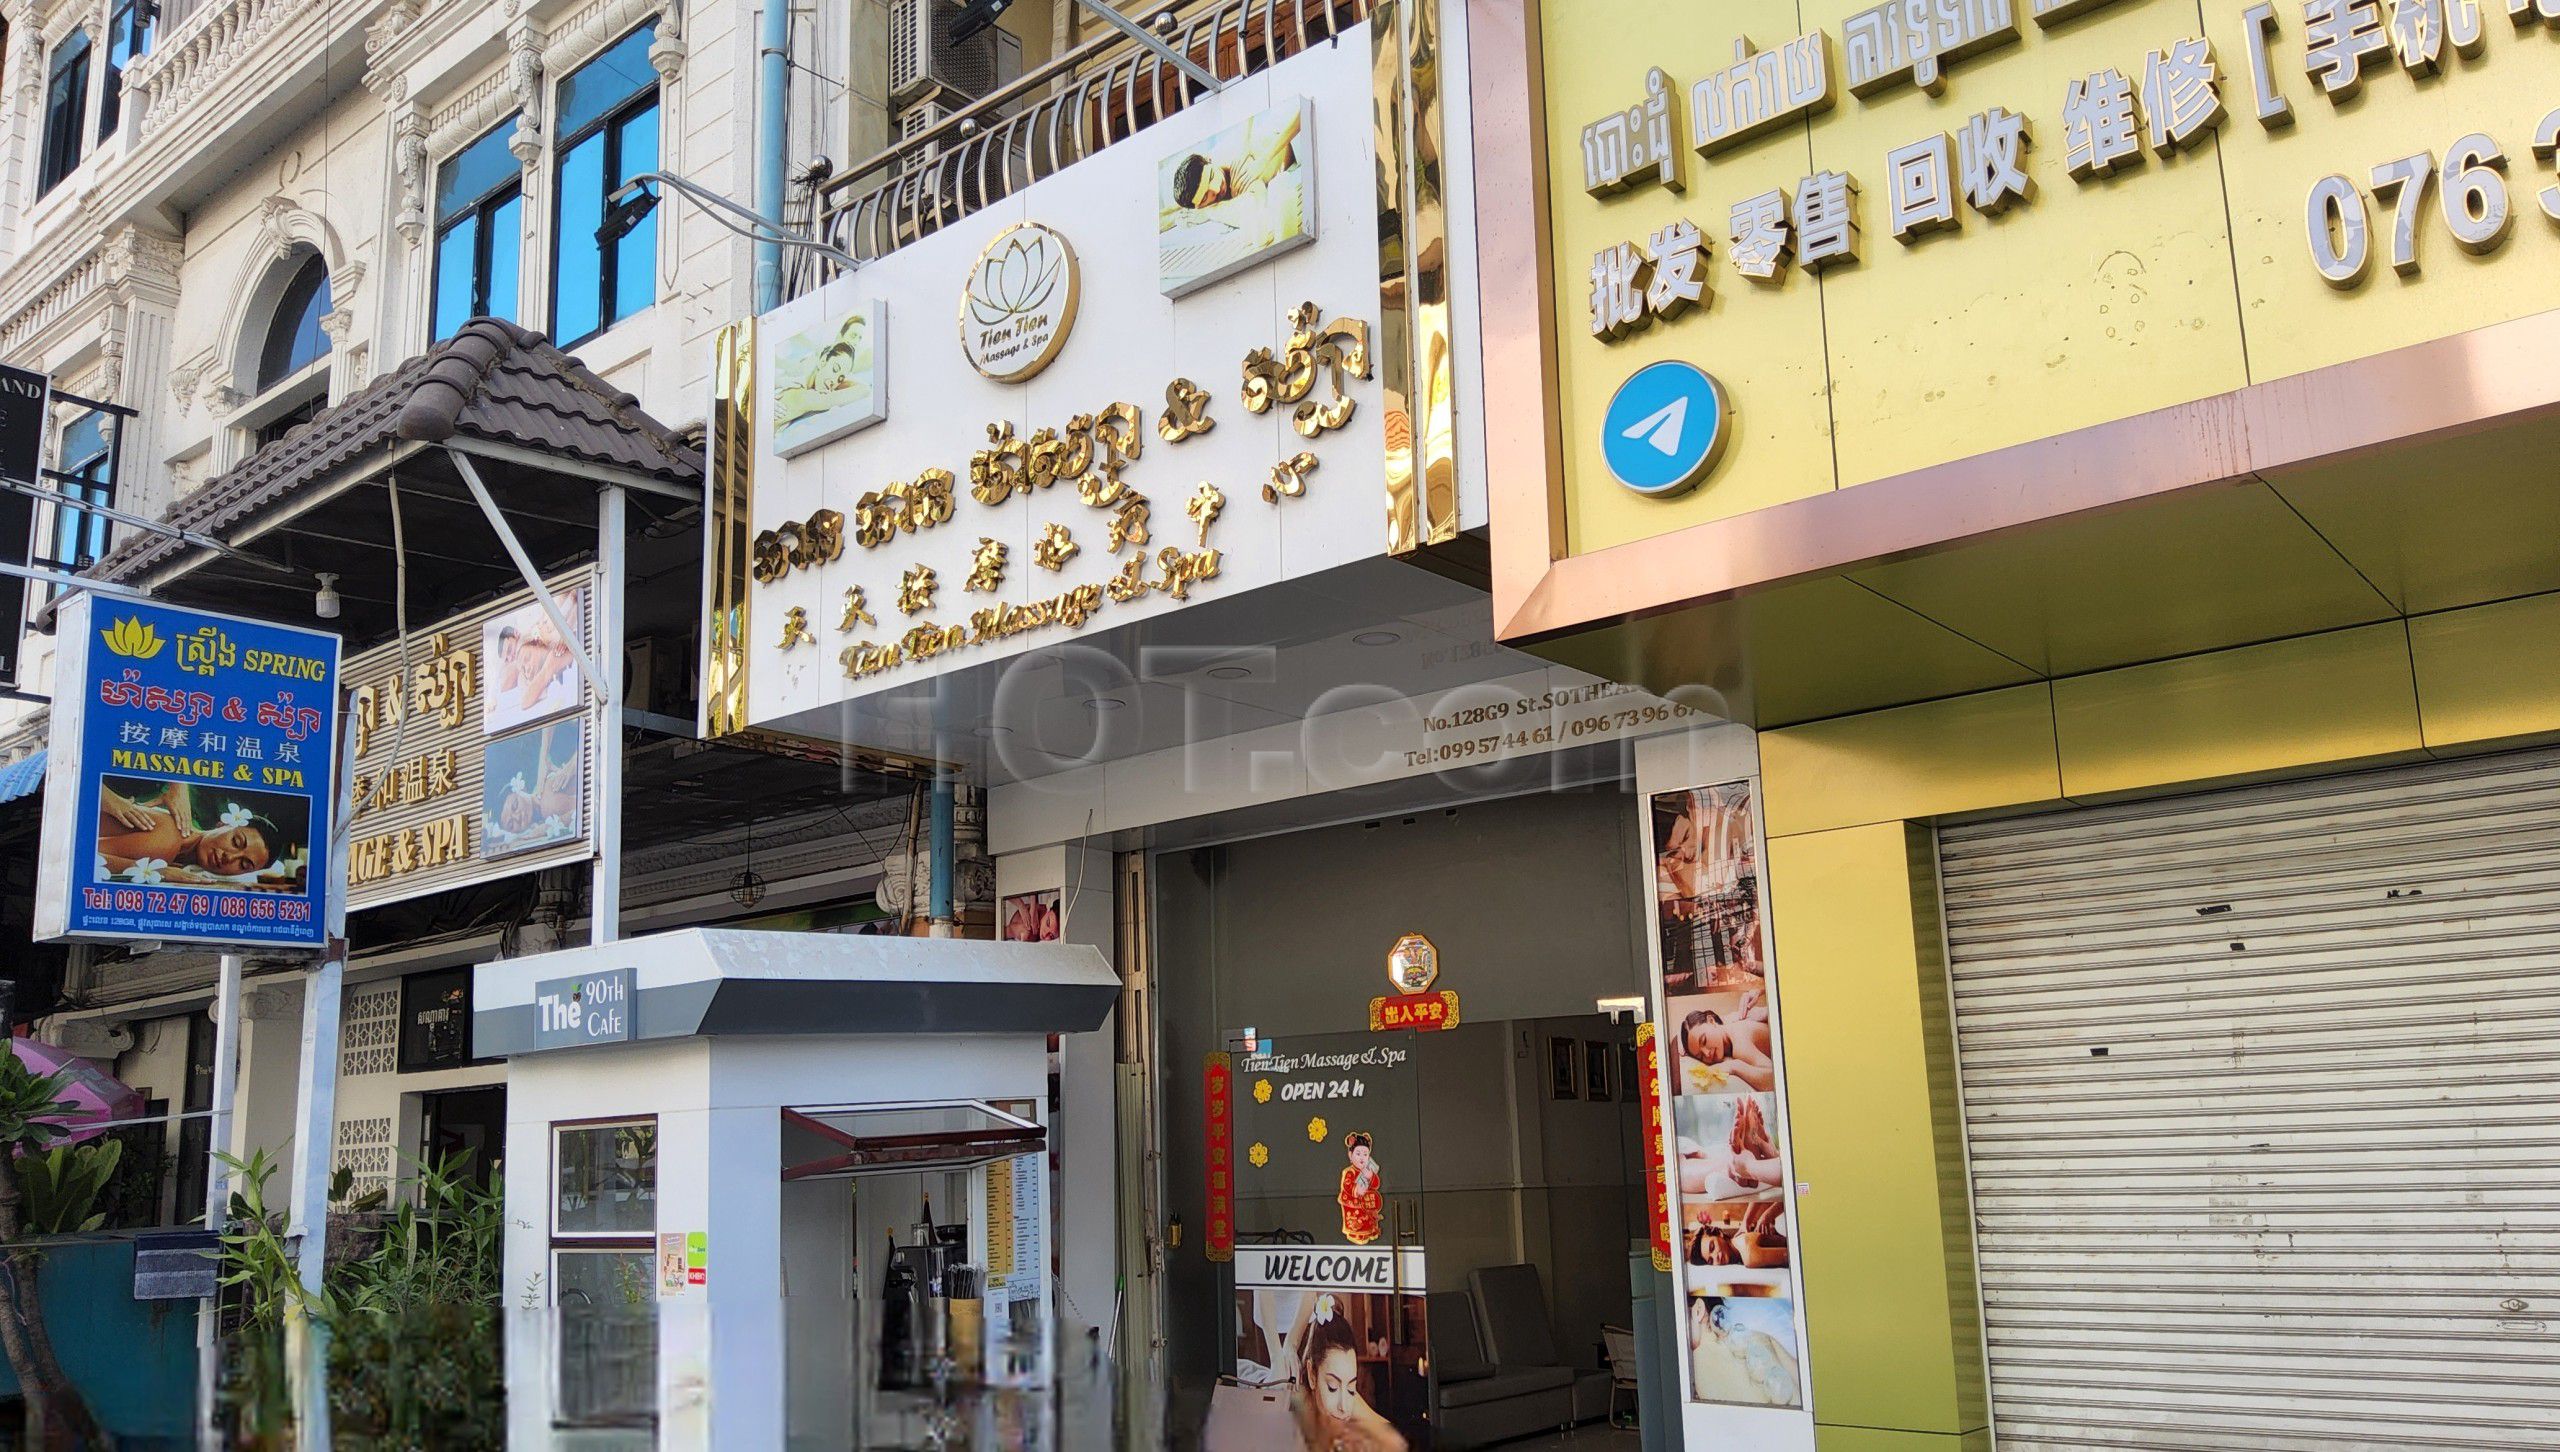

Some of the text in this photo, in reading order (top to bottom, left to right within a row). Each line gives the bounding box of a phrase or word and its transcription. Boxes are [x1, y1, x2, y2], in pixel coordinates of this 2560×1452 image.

[1588, 217, 1712, 342] 批发
[1729, 170, 1860, 284] 零售
[1886, 106, 2036, 243] 回收
[2061, 37, 2226, 180] 维修
[979, 332, 1049, 366] Massage & Spa
[1158, 377, 1217, 443] &
[1150, 547, 1223, 602] Spa
[243, 650, 326, 682] SPRING
[222, 697, 247, 722] &
[1423, 703, 1510, 734] No.128G9
[119, 721, 301, 763] 按摩和温泉
[1478, 736, 1499, 755] 57
[1503, 731, 1529, 750] 44
[1532, 725, 1555, 745] 61
[1571, 714, 1610, 737] 096
[1613, 710, 1640, 730] 73
[1642, 704, 1669, 723] 96
[111, 749, 304, 788] MASSAGE & SPA
[393, 829, 416, 872] &
[420, 814, 469, 867] SPA
[83, 888, 111, 910] Tel:
[115, 891, 143, 912] 098
[147, 893, 167, 913] 72
[169, 894, 188, 914] 47
[191, 895, 209, 916] 69
[220, 897, 246, 918] 088
[250, 899, 275, 919] 656
[279, 900, 312, 921] 5231
[538, 994, 582, 1032] The
[1384, 1001, 1443, 1025] 出入平安
[1241, 1057, 1270, 1073] Tien
[1269, 1054, 1299, 1072] Tien
[1300, 1050, 1360, 1071] Massage
[1361, 1047, 1378, 1064] &
[1377, 1047, 1407, 1068] Spa
[1280, 1079, 1365, 1101] OPEN 24 h
[1264, 1253, 1391, 1284] WELCOME
